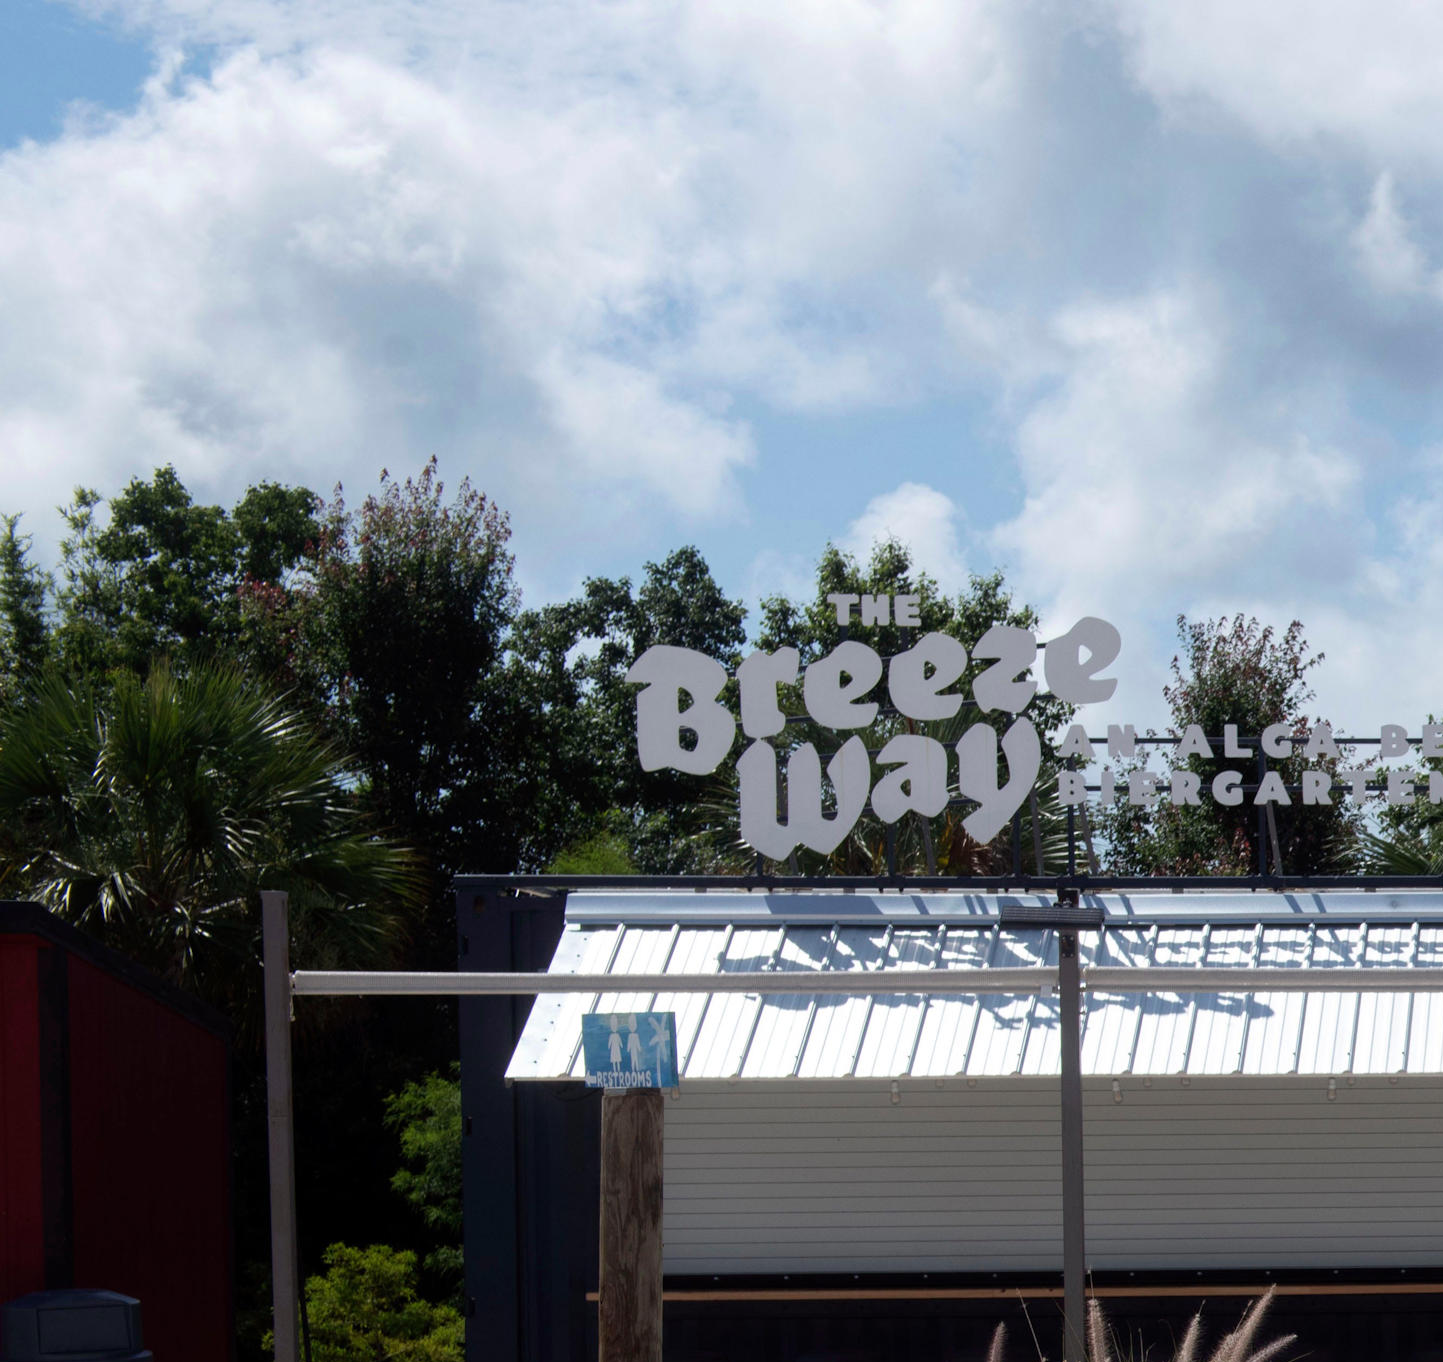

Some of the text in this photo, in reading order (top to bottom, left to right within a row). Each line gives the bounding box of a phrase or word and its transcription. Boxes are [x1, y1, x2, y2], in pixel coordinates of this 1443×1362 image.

[826, 593, 922, 627] THE
[624, 616, 1122, 776] Breeze
[1058, 723, 1136, 758] AN
[1175, 723, 1341, 759] ALGA
[596, 1070, 652, 1088] RESTROOMS
